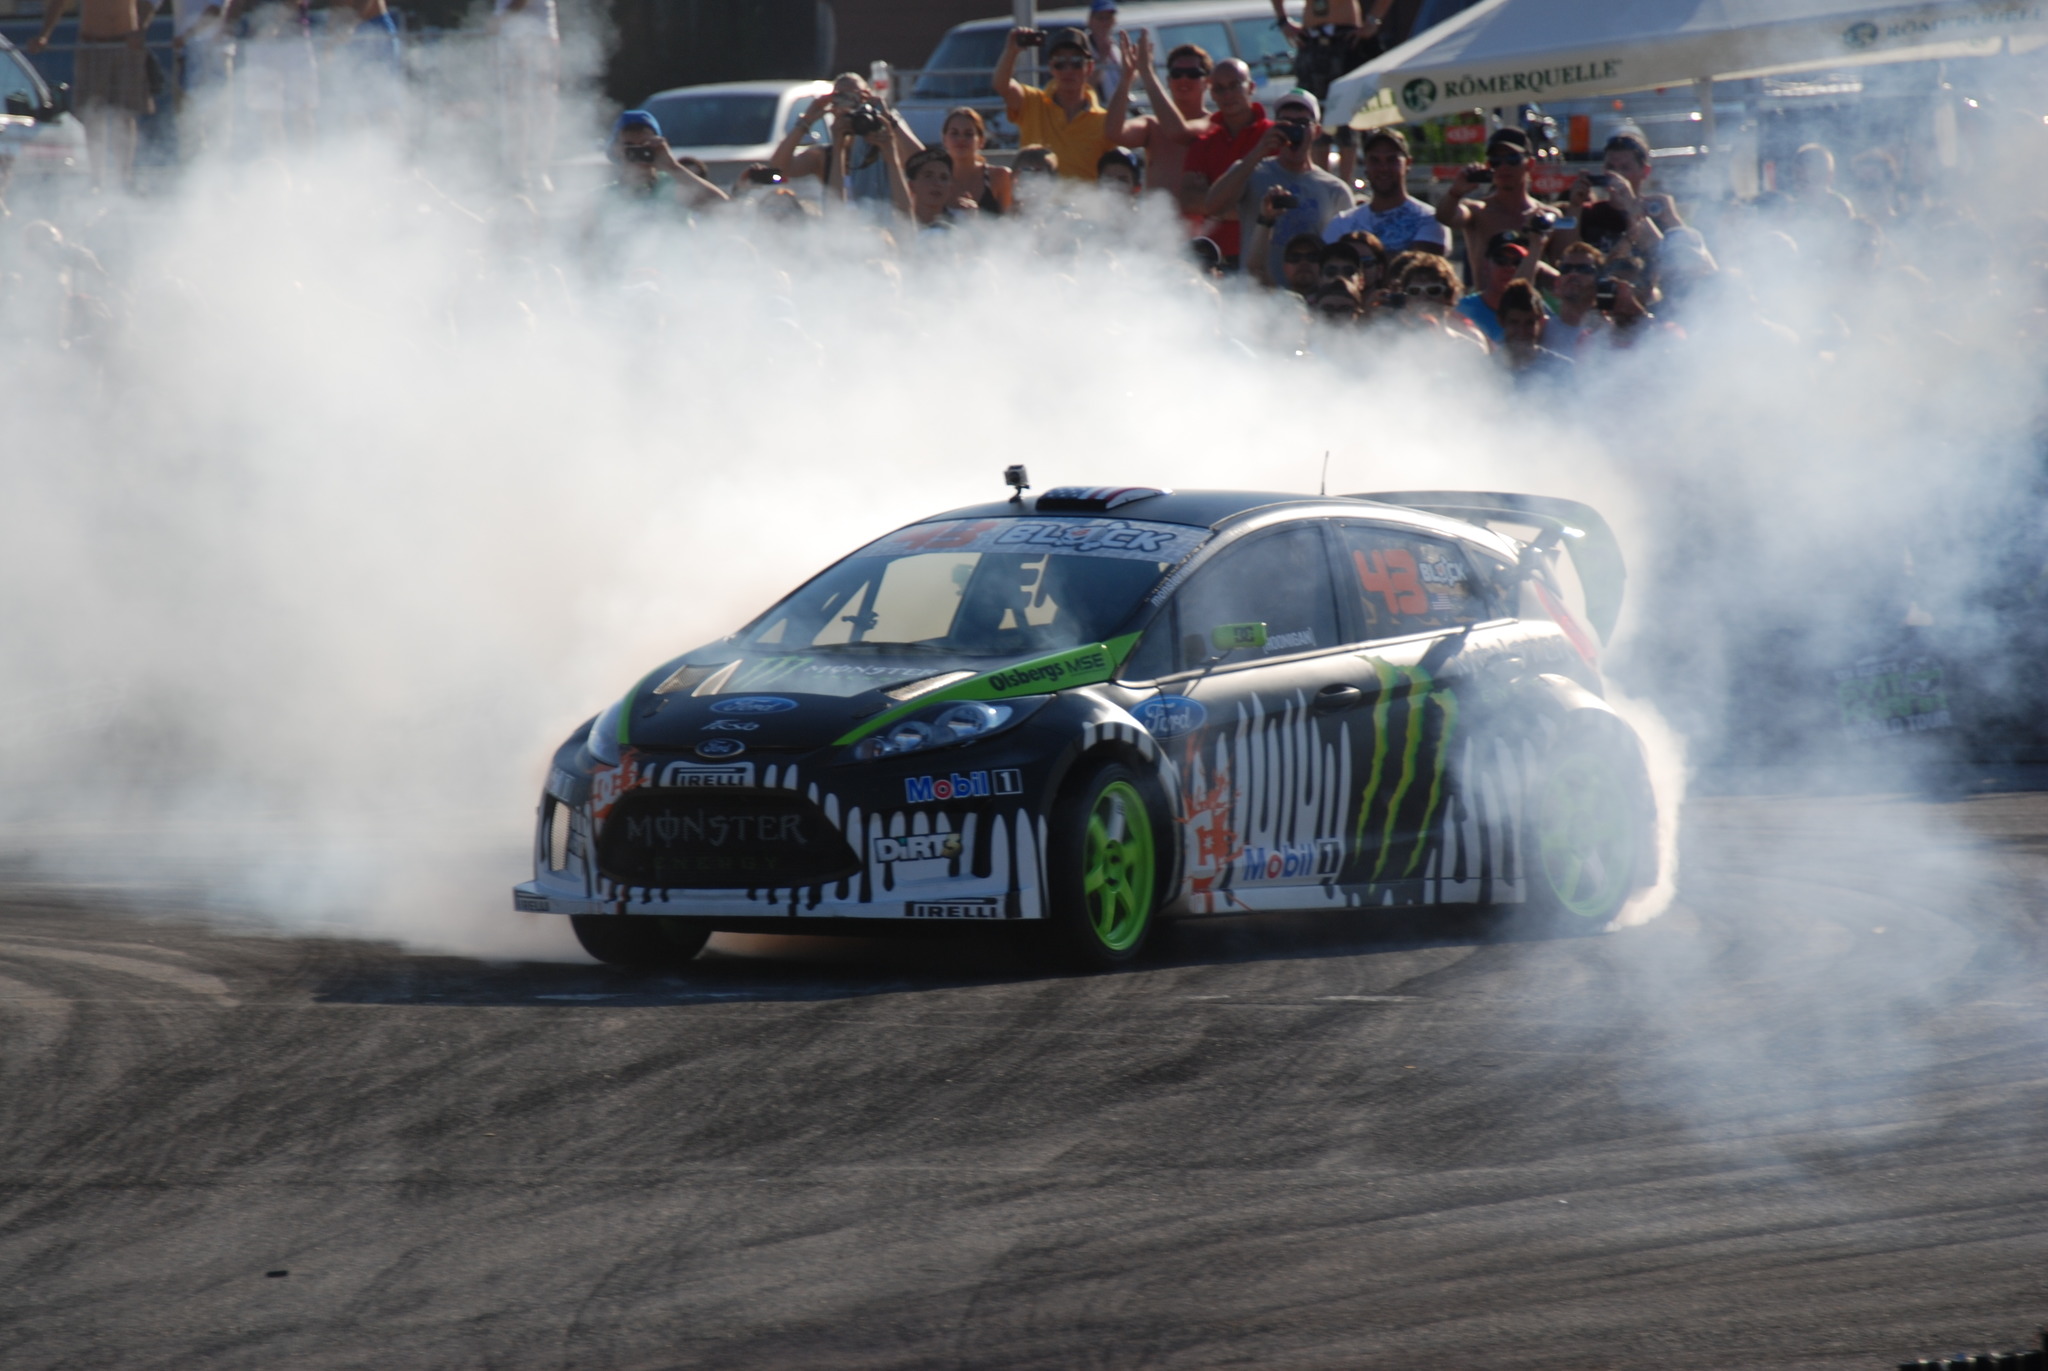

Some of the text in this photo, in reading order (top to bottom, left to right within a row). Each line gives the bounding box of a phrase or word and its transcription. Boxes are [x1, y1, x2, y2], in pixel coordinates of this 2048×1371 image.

[1444, 60, 1618, 98] RÖMERQUELLE
[1353, 549, 1429, 615] 43
[989, 653, 1106, 692] Olsbergs MSE
[1144, 702, 1192, 733] Ford
[669, 766, 747, 787] PIRELLI
[904, 771, 990, 803] Mobil
[625, 808, 808, 848] MONSTER
[1242, 843, 1314, 881] Mobil
[904, 897, 998, 919] PIRELLI
